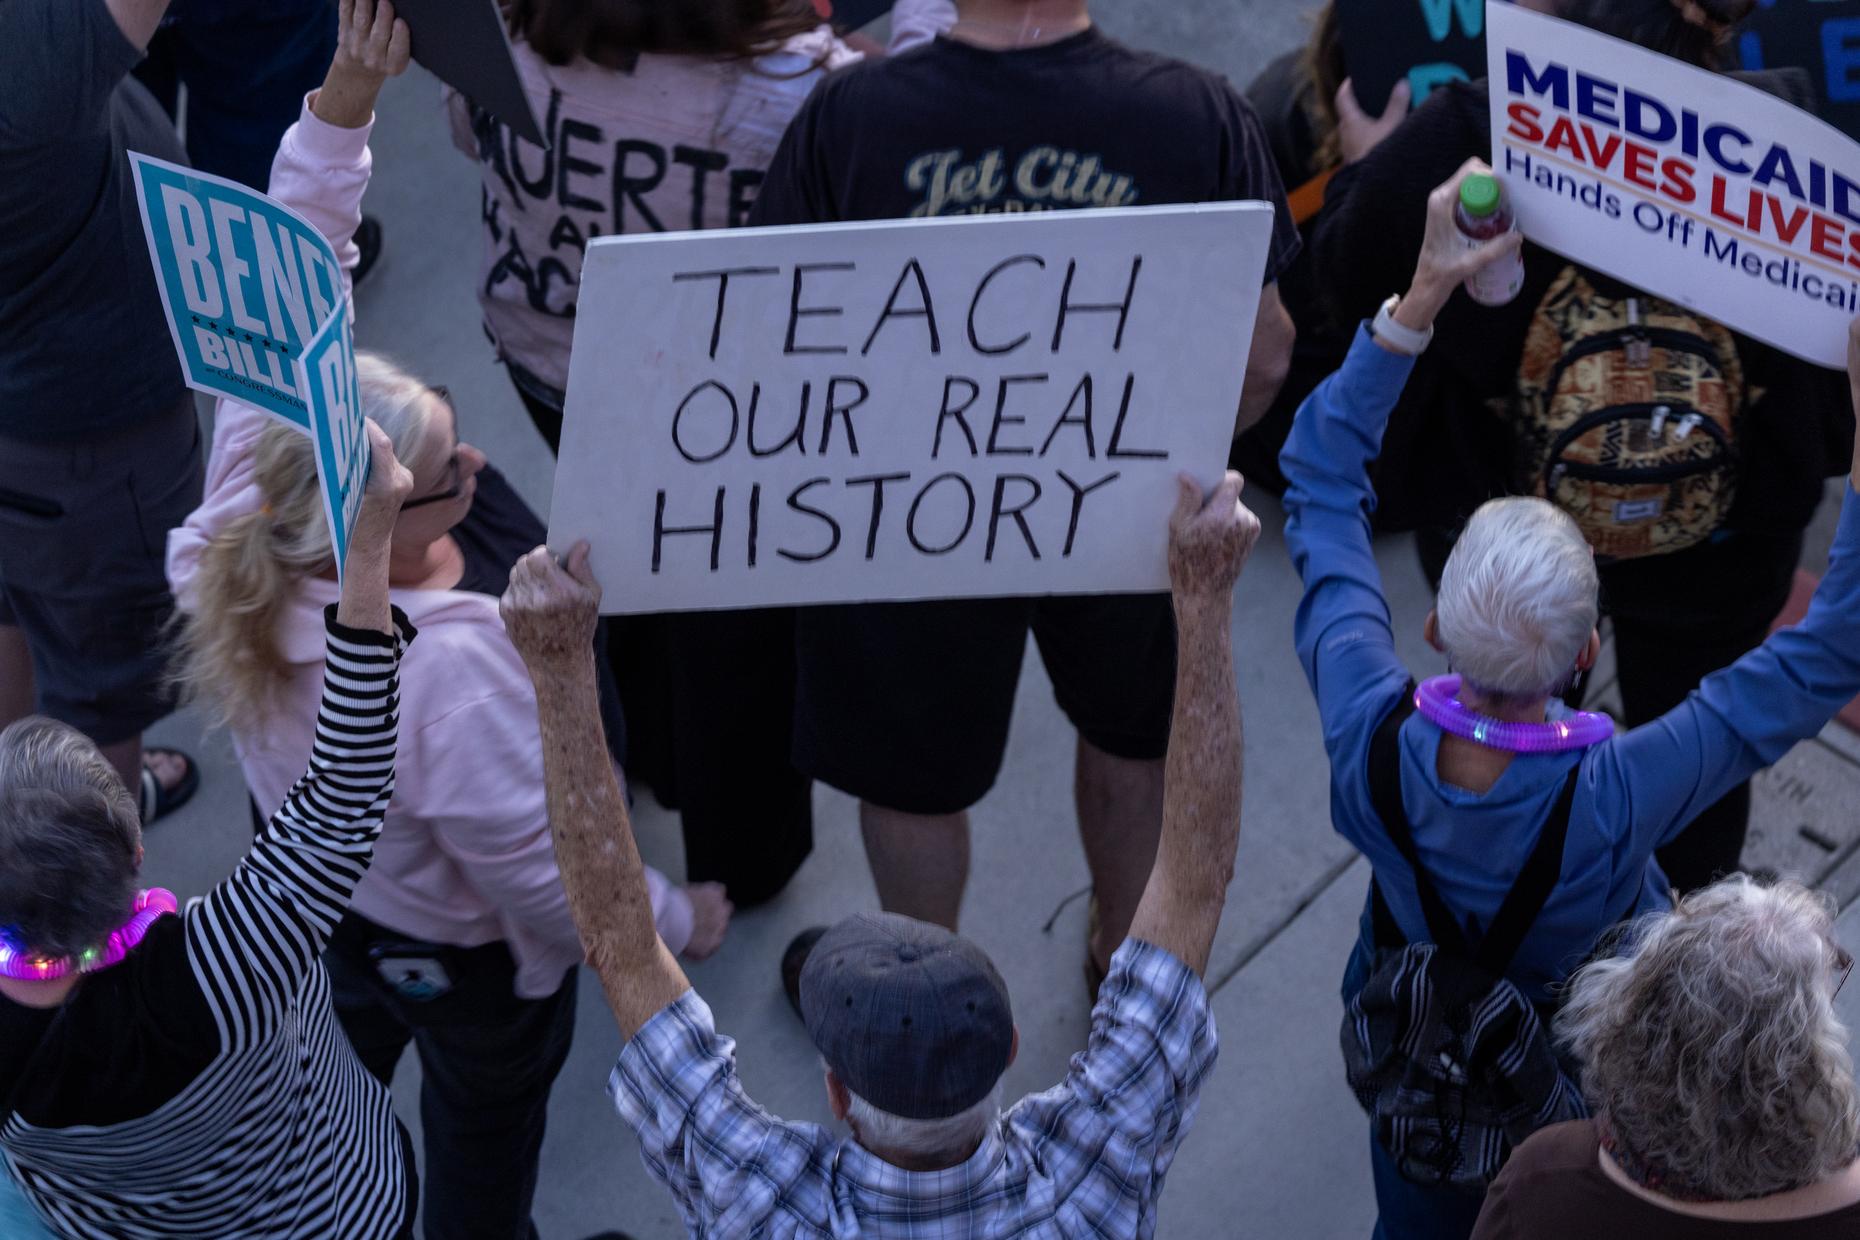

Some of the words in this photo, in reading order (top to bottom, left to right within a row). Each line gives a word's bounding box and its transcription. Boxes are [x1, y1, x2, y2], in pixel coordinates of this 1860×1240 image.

[905, 148, 1005, 216] Jet
[1016, 146, 1138, 206] City
[1507, 102, 1697, 204] SAVES
[1506, 146, 1621, 219] Hands
[1633, 201, 1695, 248] Off
[1703, 227, 1860, 314] Medicai
[673, 254, 1143, 360] TEACH
[671, 376, 870, 464] OUR
[932, 373, 1169, 460] REAL
[651, 470, 1121, 573] HISTORY
